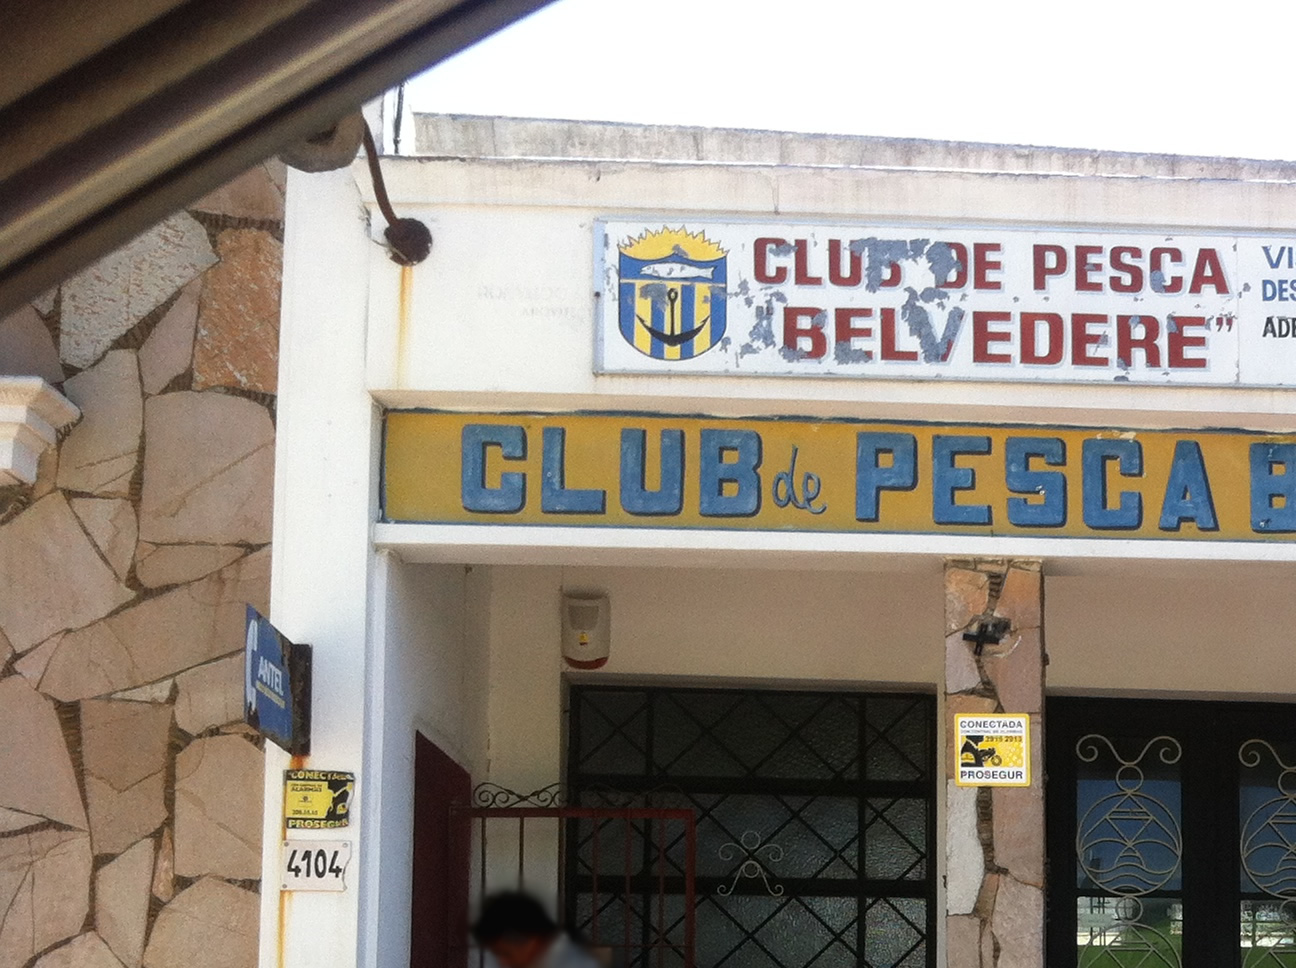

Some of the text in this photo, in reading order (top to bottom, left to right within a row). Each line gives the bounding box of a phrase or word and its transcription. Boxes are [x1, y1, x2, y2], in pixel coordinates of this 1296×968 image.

[753, 237, 1231, 295] CLUB DE PESCA
[460, 423, 763, 518] CLUB
[771, 445, 828, 516] de
[855, 431, 1220, 533] PESCA
[258, 655, 284, 697] ANTEL
[960, 720, 1023, 729] CONECTADA
[960, 770, 1023, 780] PROSEGUR
[287, 849, 342, 878] 4104
